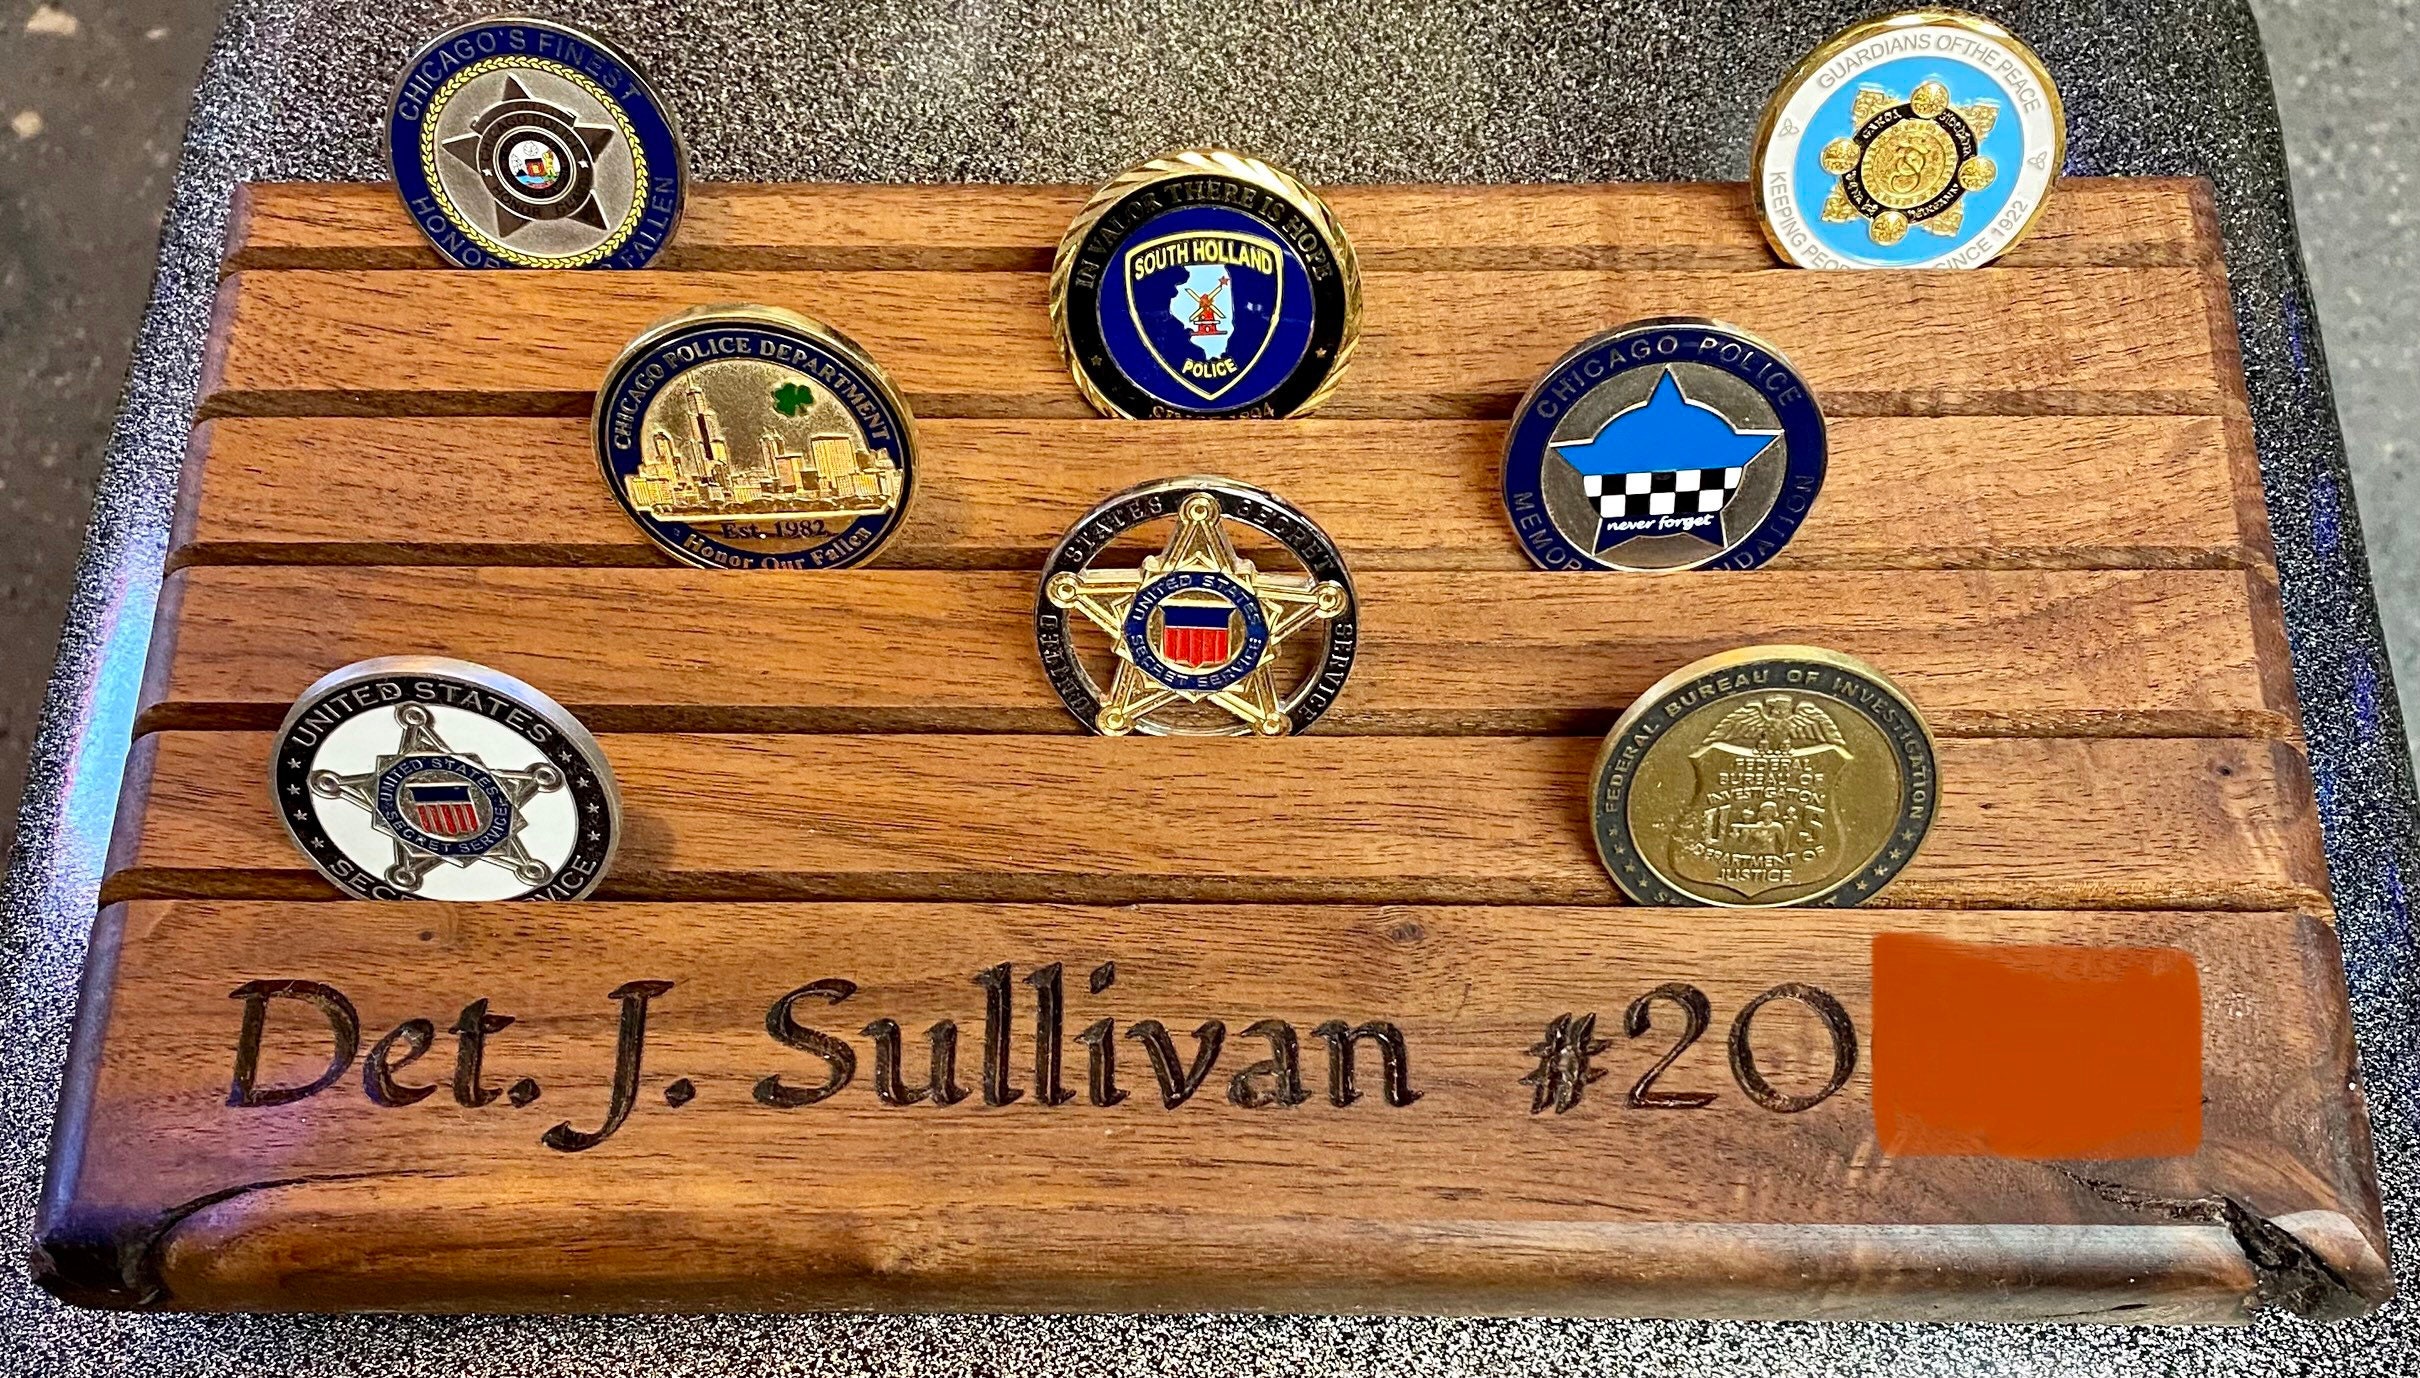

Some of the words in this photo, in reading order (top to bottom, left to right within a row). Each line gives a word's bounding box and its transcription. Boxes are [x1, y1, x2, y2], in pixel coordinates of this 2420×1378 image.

[398, 29, 527, 121] CHICAGO'S
[538, 35, 642, 100] FINEST
[1817, 33, 1931, 89] GUARDIANS
[1994, 59, 2042, 114] PEACE
[619, 176, 675, 268] FALLEN
[1074, 259, 1100, 289] IN
[1088, 193, 1163, 254] VALOR
[1164, 179, 1257, 205] THERE
[1258, 196, 1286, 221] IS
[1282, 211, 1334, 281] HOPE
[1769, 171, 1808, 248] KEEPING
[1991, 200, 2028, 237] 1922
[1133, 243, 1189, 281] SOUTH
[1192, 240, 1273, 275] HOLLAND
[614, 364, 664, 450] CHICAGO
[661, 337, 752, 370] POLICE
[759, 340, 892, 442] DEPARTMENT
[1182, 358, 1238, 378] POLICE
[1536, 335, 1679, 419] CHICAGO
[1700, 336, 1802, 406] POLICE
[683, 533, 754, 569] Honor
[809, 526, 872, 565] Fallen
[720, 520, 768, 539] Est.
[774, 519, 830, 538] 1982
[1606, 519, 1656, 531] never
[1658, 513, 1714, 531] forget
[1064, 497, 1163, 563] STATES
[1236, 500, 1337, 580] SECRET
[1297, 623, 1353, 723] SERVICE
[1132, 574, 1192, 621] UNITED
[1202, 575, 1262, 625] STATES
[1131, 634, 1189, 686] SECRET
[1198, 637, 1262, 688] SERVICE
[292, 682, 402, 748] UNITED
[413, 681, 553, 744] STATES
[1604, 722, 1659, 813] FEDERAL
[1663, 670, 1769, 719] BUREAU
[1786, 670, 1820, 684] OF
[1833, 676, 1926, 821] INVESTIGATION
[1735, 757, 1813, 772] FEDERAL
[380, 759, 423, 802] UNITED
[431, 757, 499, 796] STATES
[1705, 786, 1826, 804] INVESTIGATION
[1719, 772, 1791, 786] BUREAU
[1799, 772, 1825, 786] OF
[386, 810, 451, 853] SECRET
[459, 805, 508, 853] SERVICE
[1692, 842, 1796, 867] DEPARTMENT
[1802, 845, 1825, 862] OF
[1716, 867, 1793, 884] JUSTICE
[224, 977, 542, 1110] Det.
[541, 977, 695, 1152] J.
[750, 959, 1425, 1111] Sullivan
